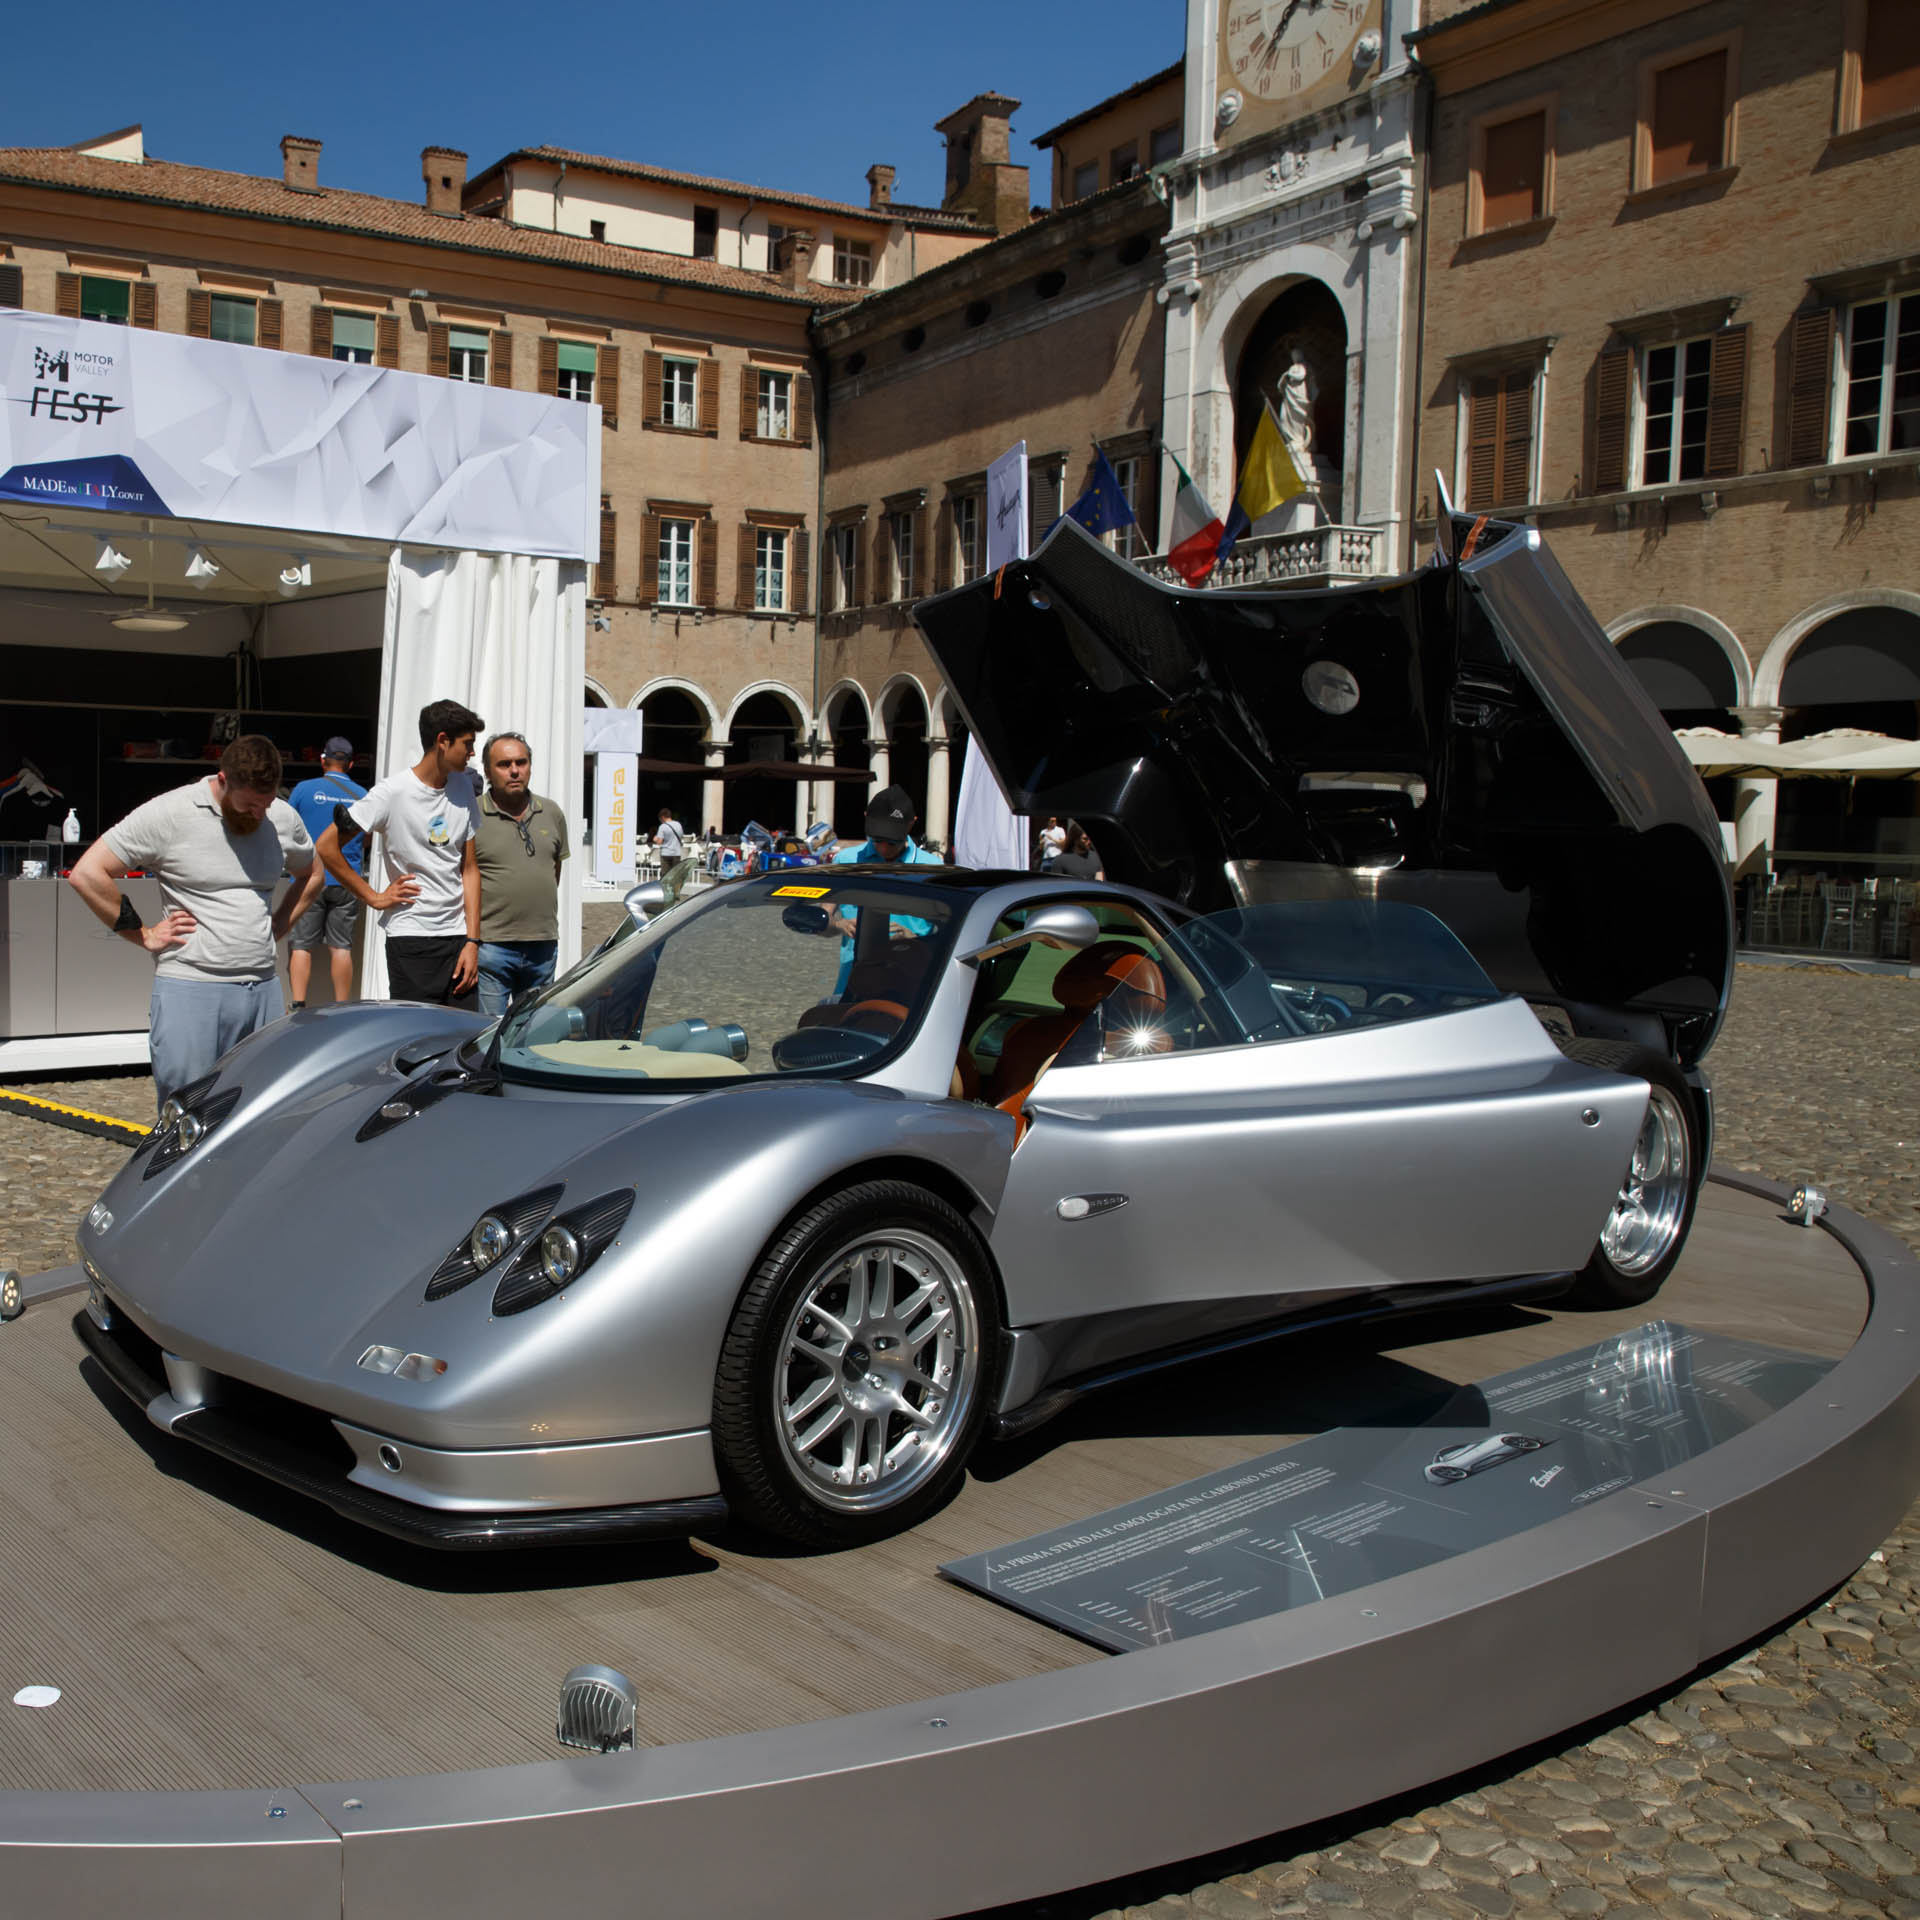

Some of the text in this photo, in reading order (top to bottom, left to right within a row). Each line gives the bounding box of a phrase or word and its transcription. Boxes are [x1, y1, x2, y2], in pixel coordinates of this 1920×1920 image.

[74, 352, 114, 366] MOTOR
[74, 364, 110, 377] VALLEY
[30, 386, 114, 425] FEST
[608, 767, 625, 864] dallara
[1007, 1550, 1053, 1568] PRIMA
[1048, 1528, 1118, 1554] STRADALE
[1113, 1501, 1190, 1532] OMOLOGATA
[1185, 1495, 1204, 1505] IN
[1201, 1474, 1260, 1500] CARBONIO
[1266, 1460, 1300, 1475] VISTA
